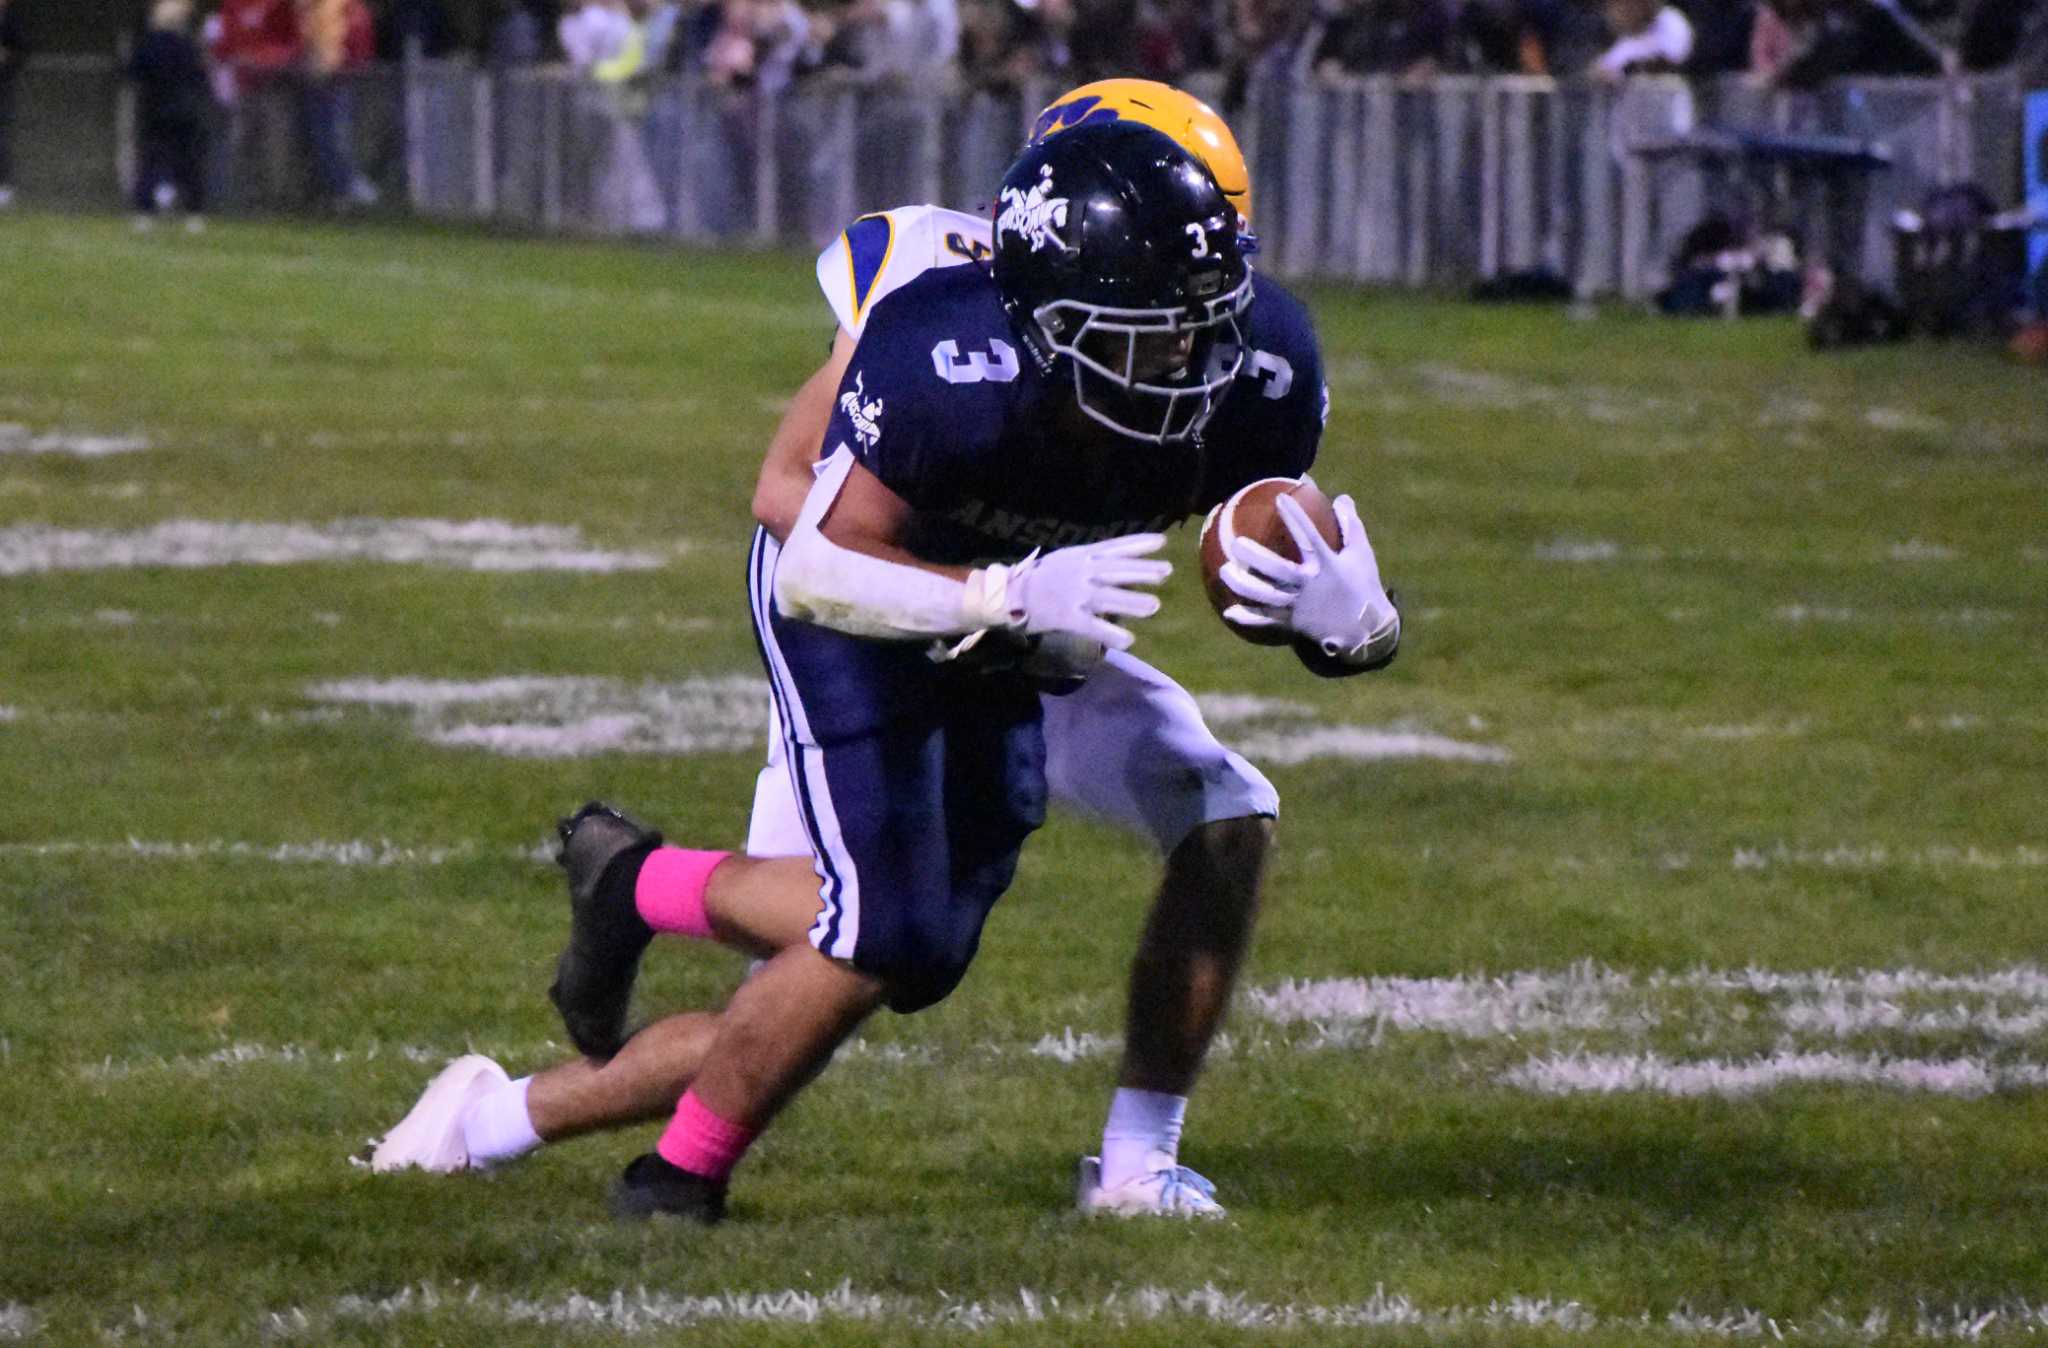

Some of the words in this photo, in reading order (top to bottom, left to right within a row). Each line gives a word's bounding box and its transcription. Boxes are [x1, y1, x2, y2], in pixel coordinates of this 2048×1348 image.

[1186, 222, 1208, 258] 3
[931, 338, 1020, 384] 3
[1203, 343, 1294, 400] 3
